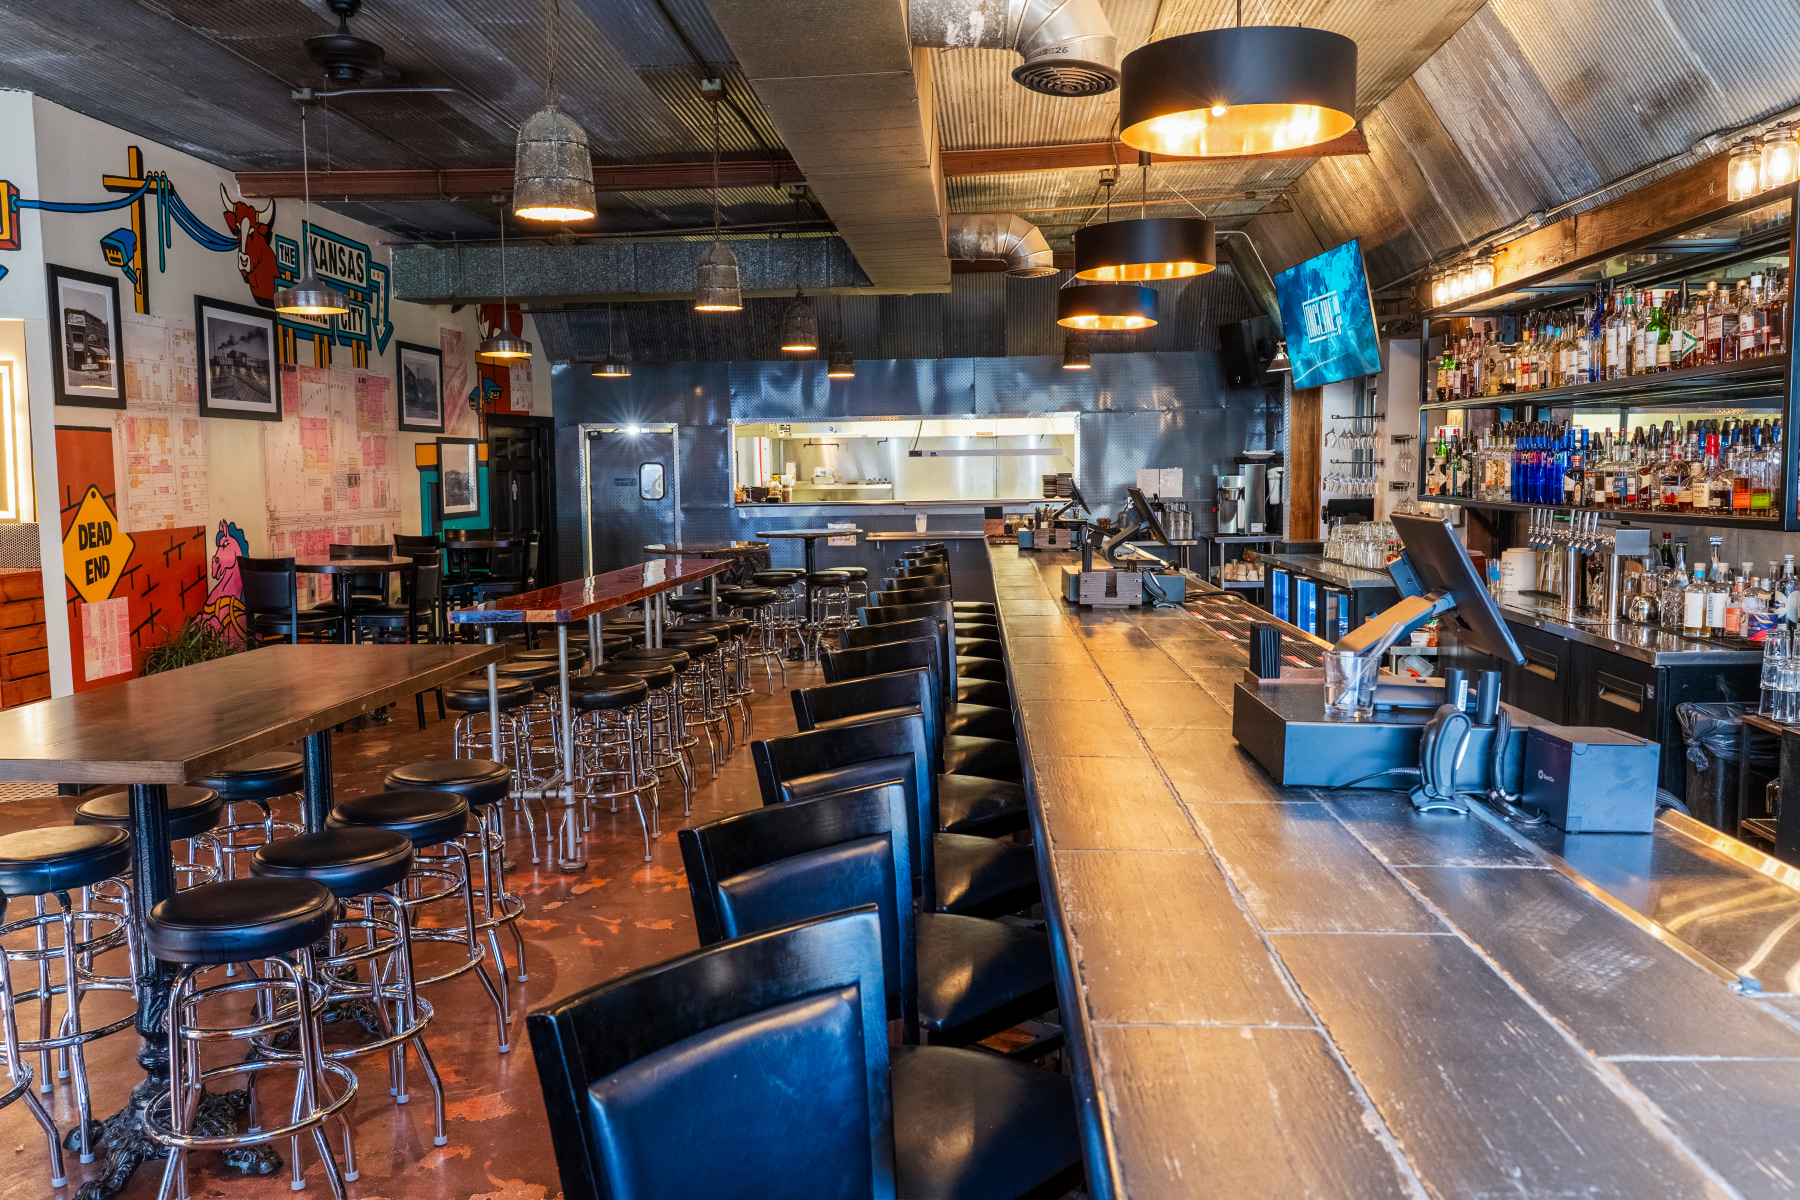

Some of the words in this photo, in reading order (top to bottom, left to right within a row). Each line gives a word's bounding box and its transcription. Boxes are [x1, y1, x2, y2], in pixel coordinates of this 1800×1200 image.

[279, 244, 296, 266] THE
[309, 236, 365, 284] KANSAS
[340, 306, 364, 333] CITY
[78, 521, 112, 551] DEAD
[85, 555, 110, 586] END
